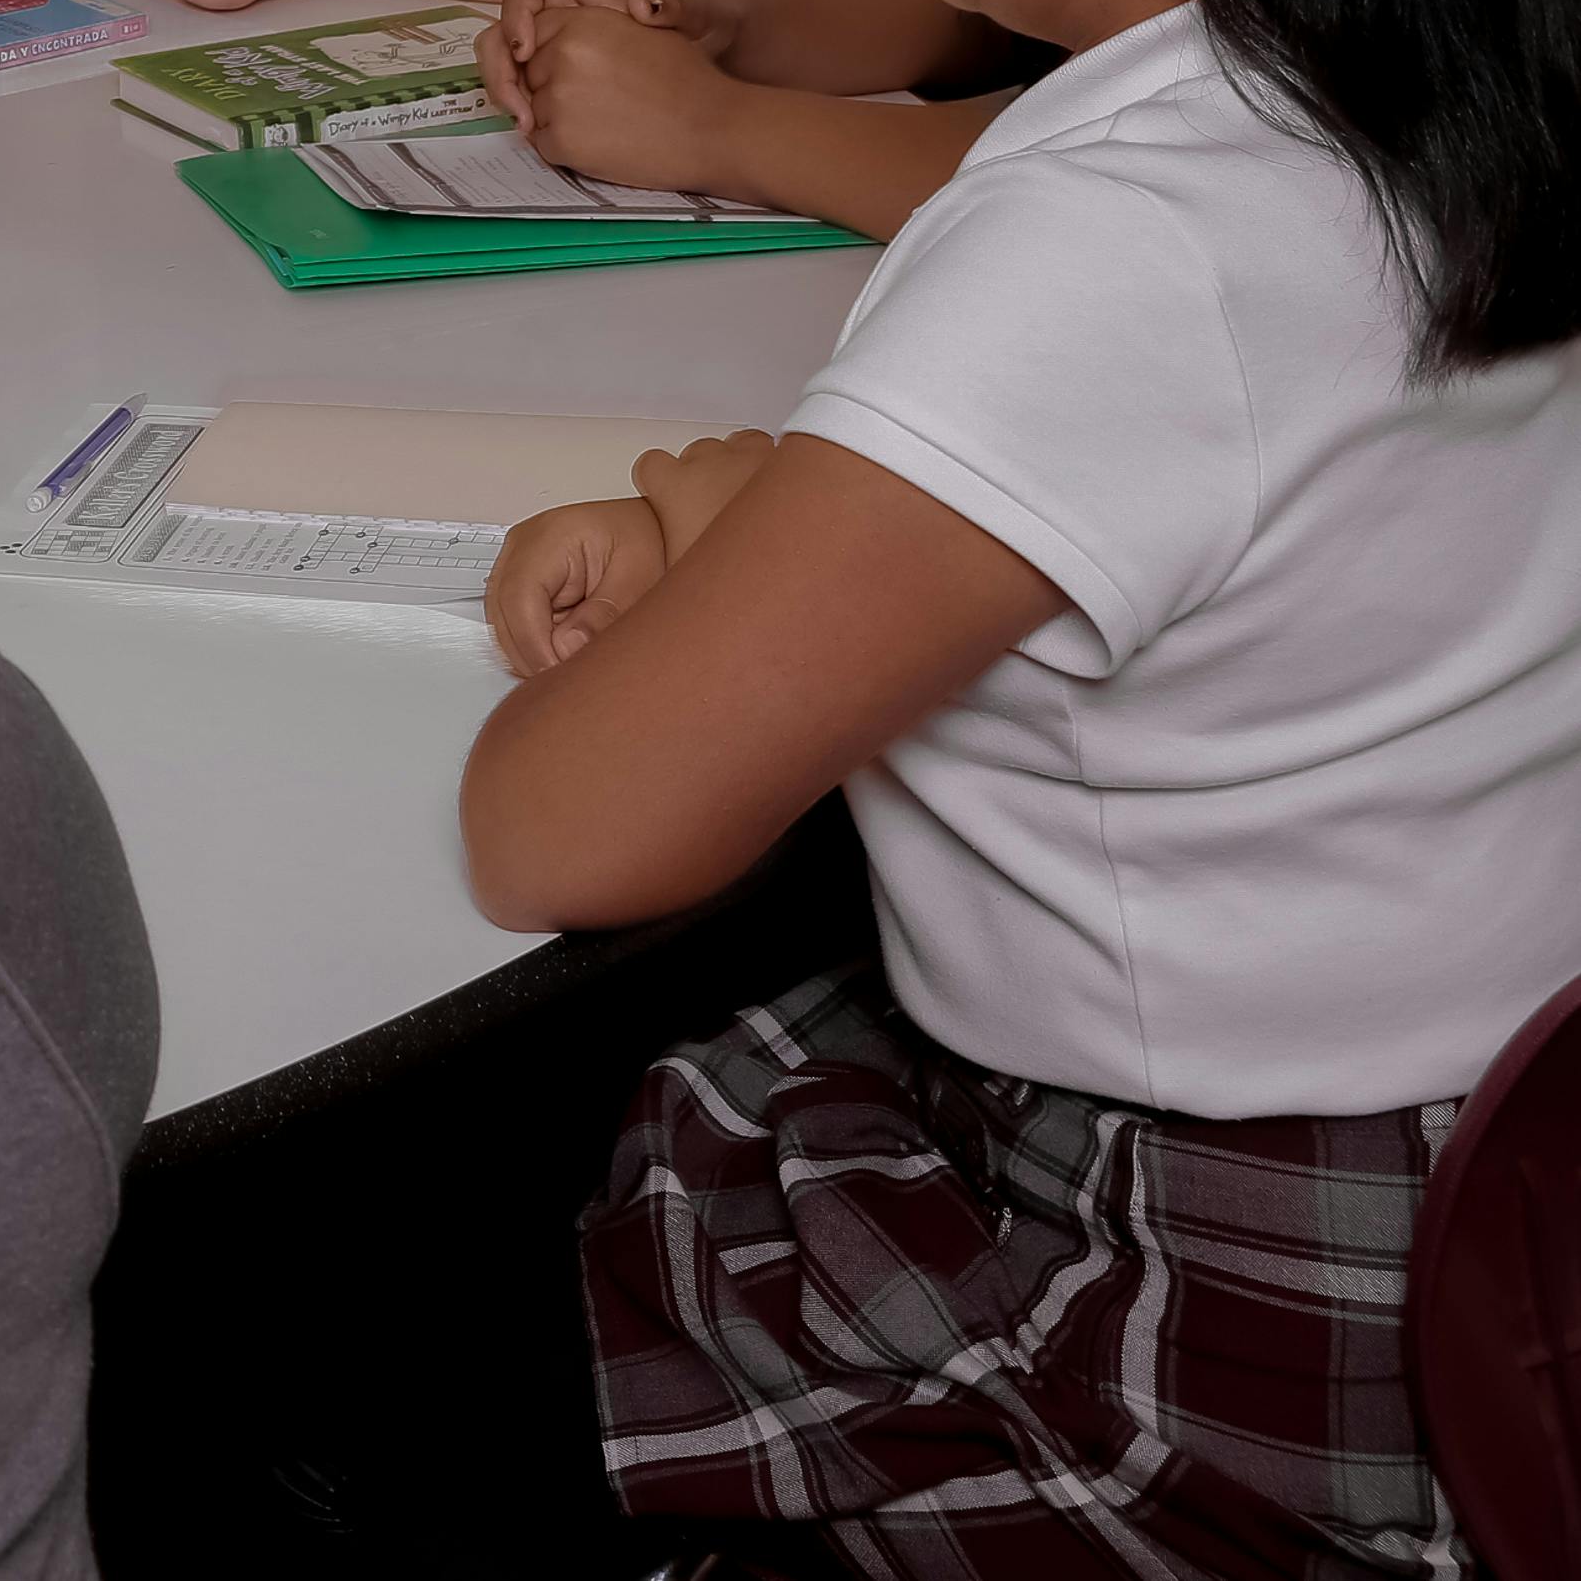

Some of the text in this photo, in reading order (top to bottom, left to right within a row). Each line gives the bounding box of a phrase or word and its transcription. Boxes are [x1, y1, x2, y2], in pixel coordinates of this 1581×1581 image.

[20, 46, 29, 58] Y
[31, 29, 109, 55] ENCONTRADA
[162, 67, 246, 101] DIARY
[328, 121, 357, 137] Diary
[378, 113, 411, 126] Wimpy
[412, 107, 428, 120] Kid
[112, 429, 185, 481] Crossword
